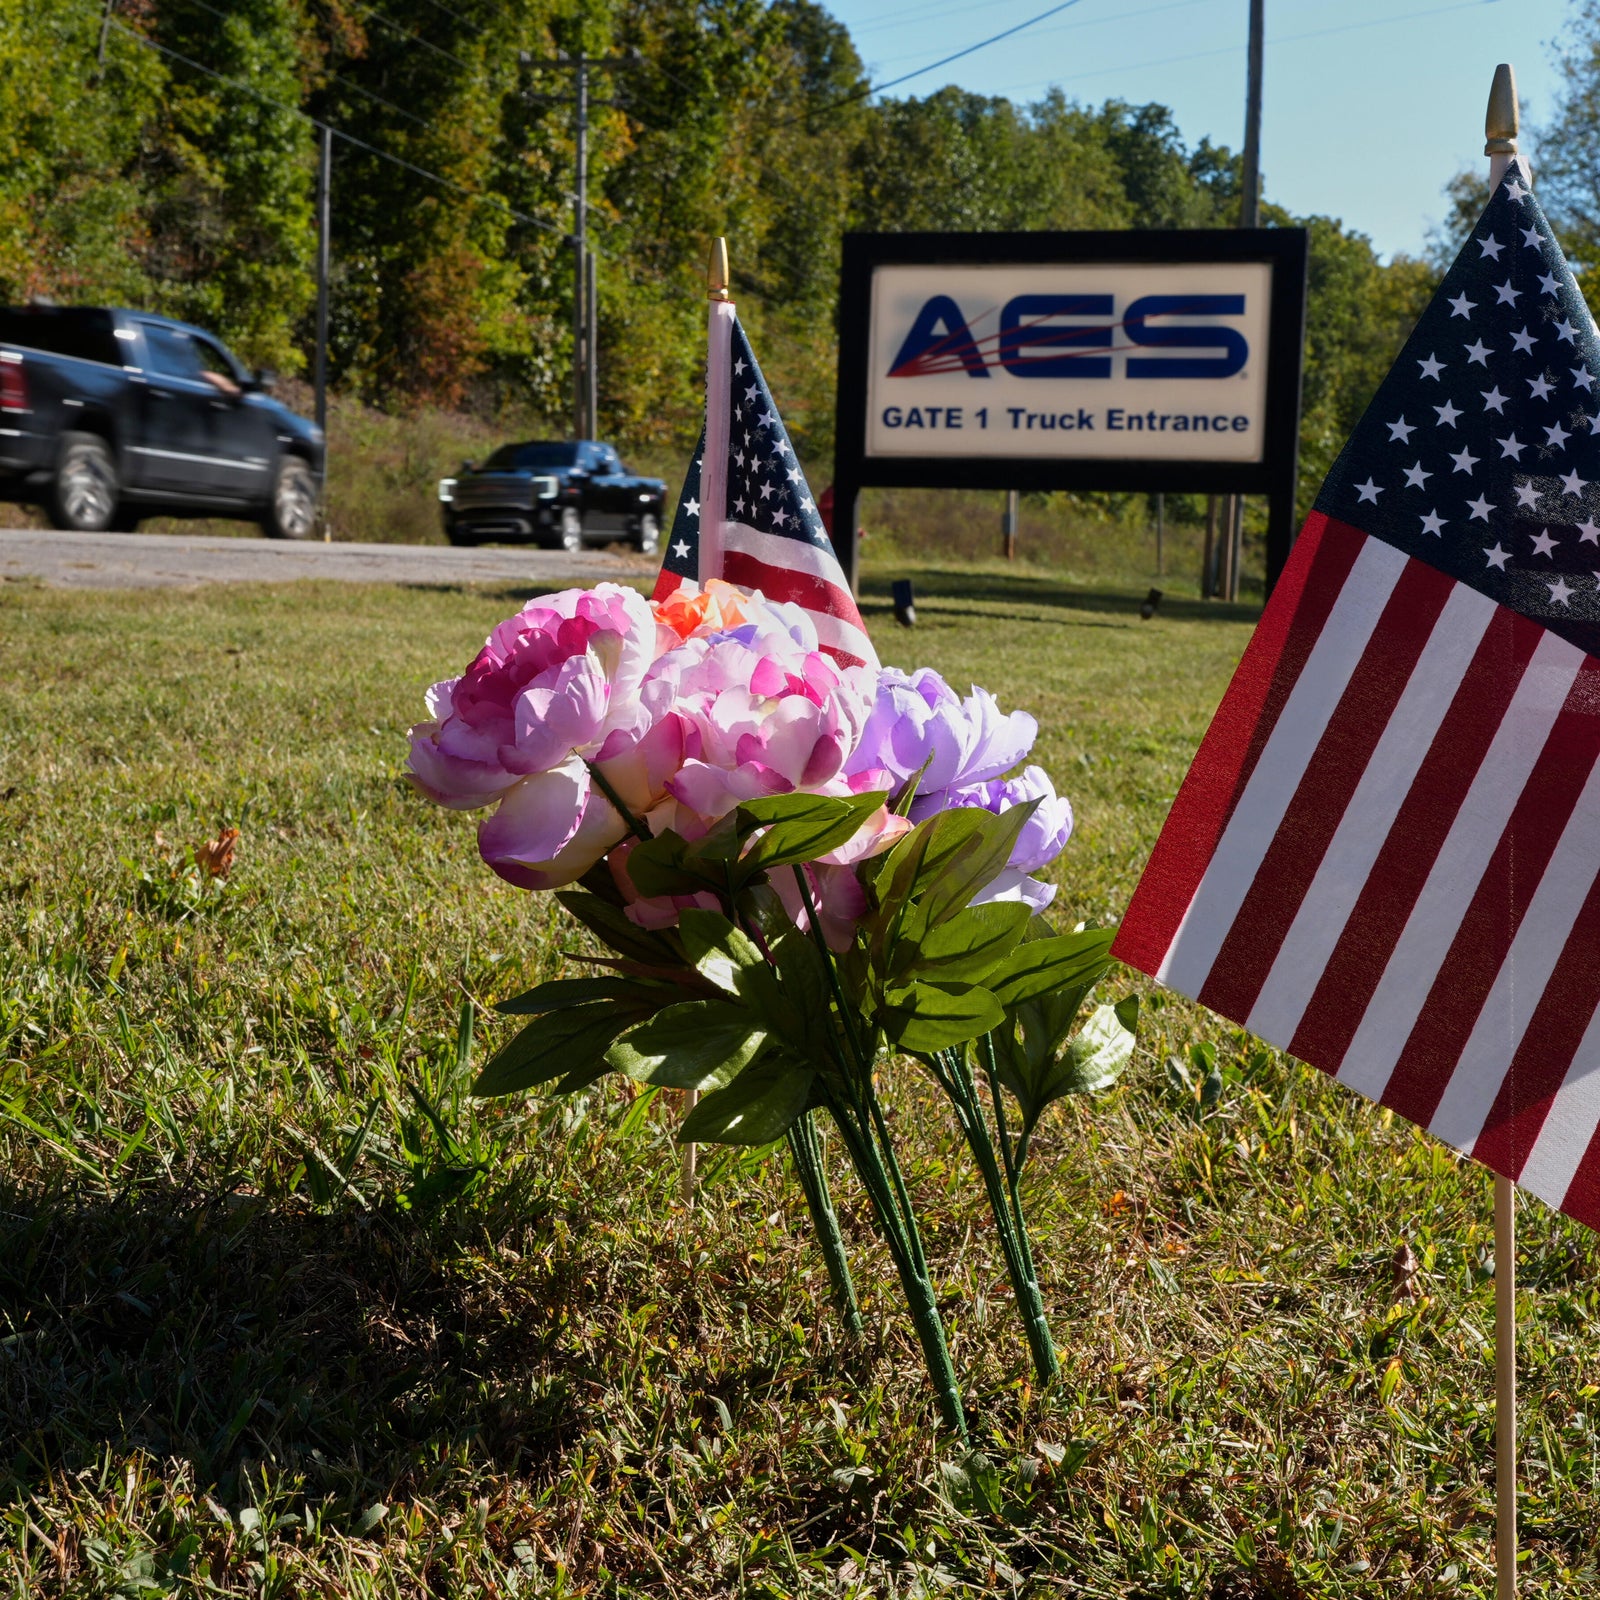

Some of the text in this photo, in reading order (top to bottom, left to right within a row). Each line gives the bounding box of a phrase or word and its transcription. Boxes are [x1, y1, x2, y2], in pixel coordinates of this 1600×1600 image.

[886, 294, 1250, 379] AES
[881, 406, 1250, 432] GATE 1 Truck Entrance
